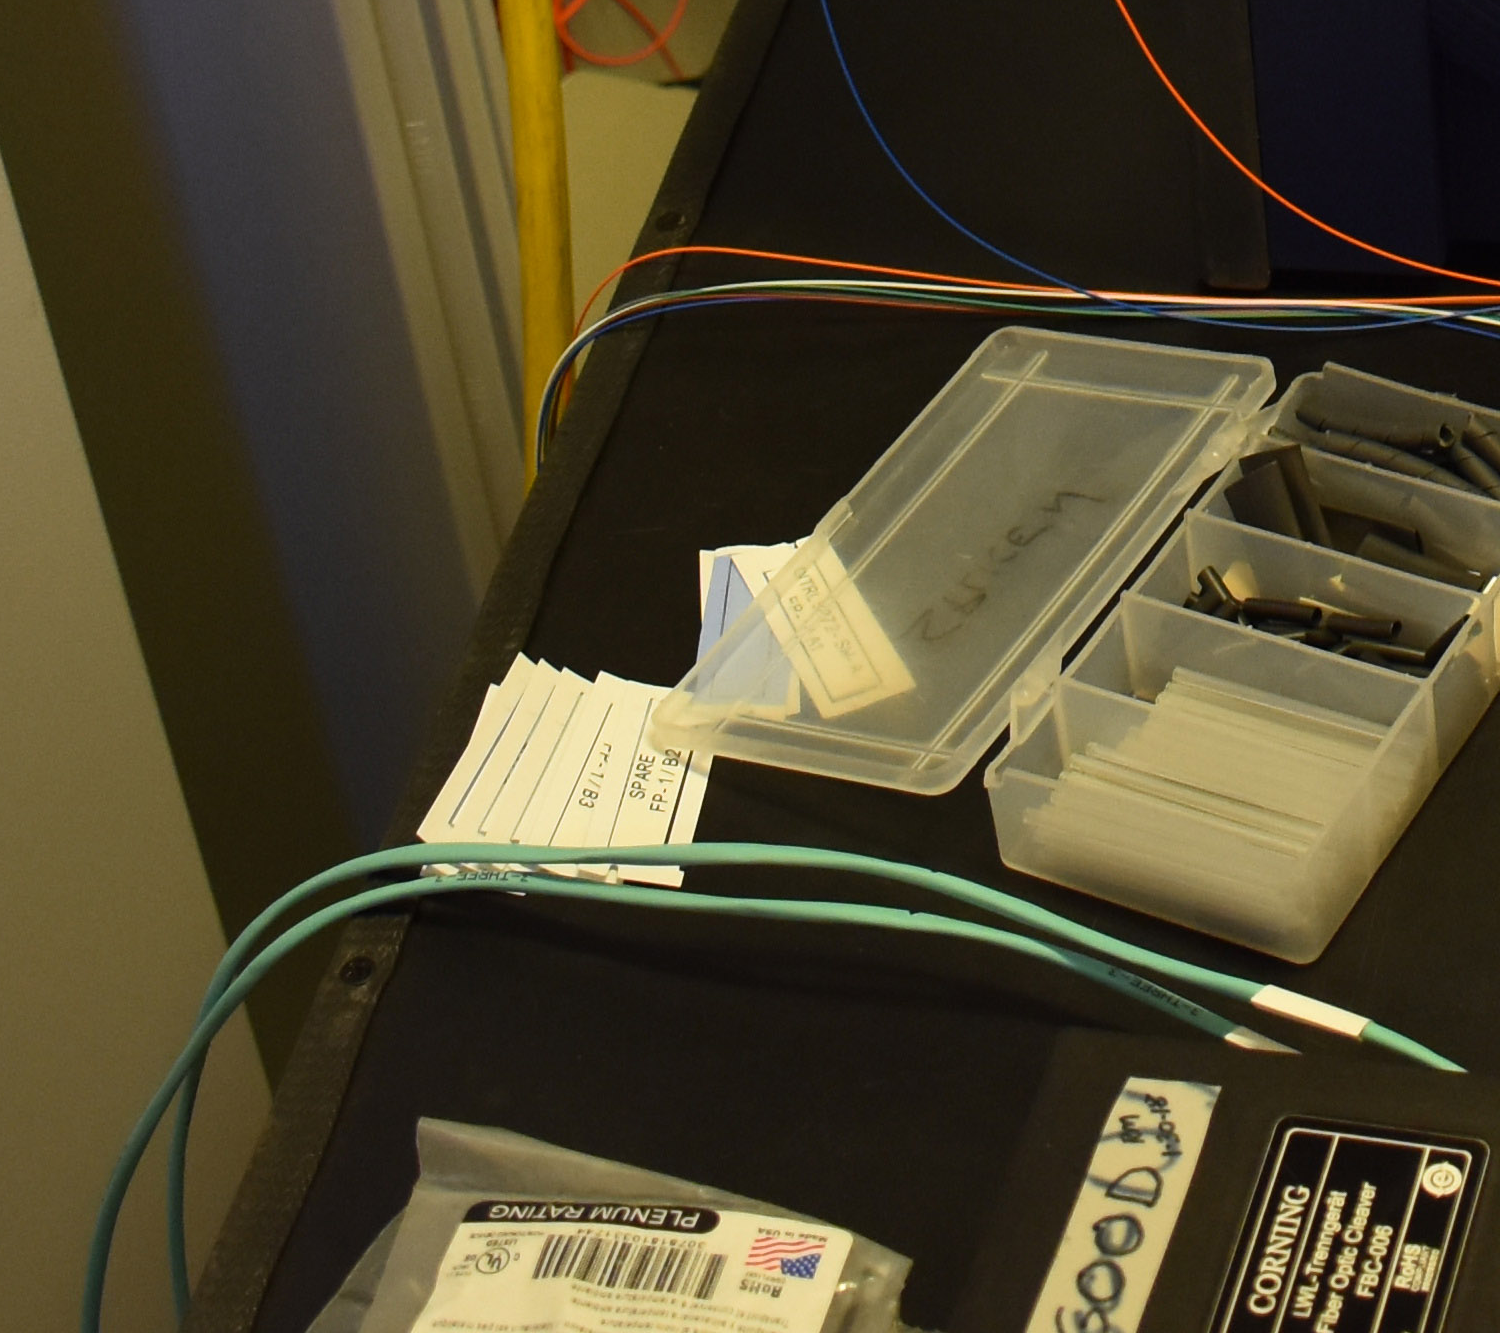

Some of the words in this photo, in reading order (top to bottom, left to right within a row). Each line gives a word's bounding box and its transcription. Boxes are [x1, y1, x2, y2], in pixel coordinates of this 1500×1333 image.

[629, 753, 656, 800] SPARE
[488, 1201, 584, 1221] RATING
[589, 1204, 700, 1230] PLENUM
[757, 1227, 780, 1237] USA
[1342, 1181, 1377, 1243] Cleaver
[1247, 1184, 1311, 1316] CORNING
[1329, 1244, 1358, 1289] Optic
[1356, 1224, 1394, 1298] FBC-006
[1395, 1243, 1422, 1290] RoHS
[739, 1278, 784, 1299] RoHS
